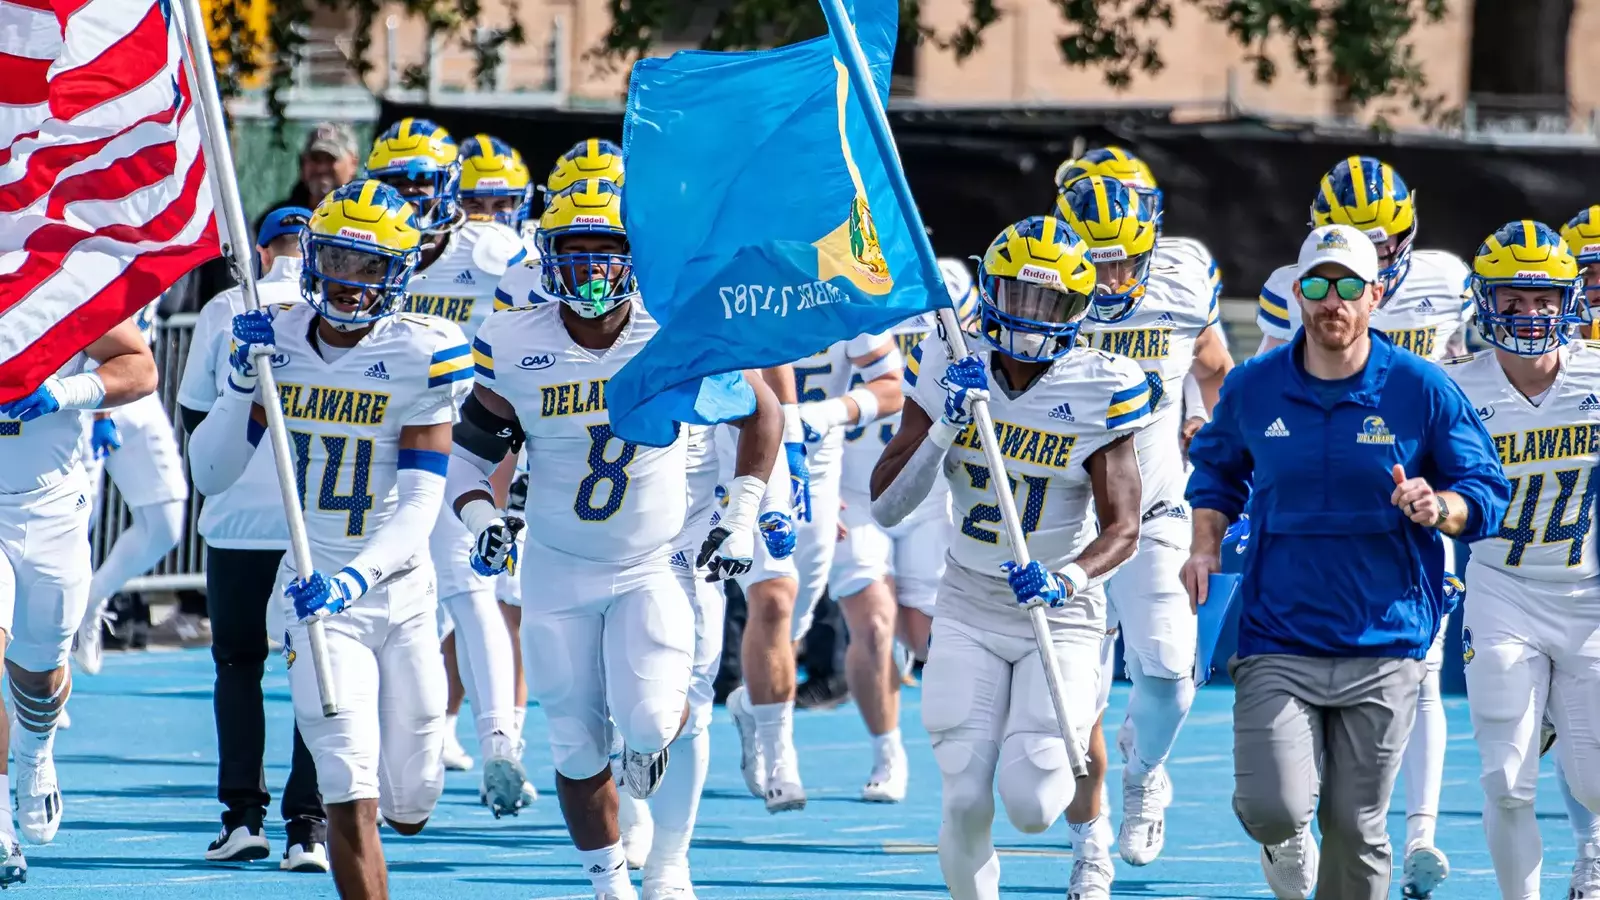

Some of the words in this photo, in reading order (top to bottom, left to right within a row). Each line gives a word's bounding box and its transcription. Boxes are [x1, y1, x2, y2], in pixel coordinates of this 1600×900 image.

[340, 228, 372, 241] Riddell
[1091, 250, 1123, 259] Riddell
[1023, 268, 1059, 282] Riddell
[521, 355, 550, 367] CAA
[363, 369, 390, 381] adidas
[277, 382, 391, 425] ELAWARE
[1048, 410, 1076, 423] adidas
[1492, 423, 1600, 467] ELAWARE
[573, 422, 638, 522] 8
[288, 429, 375, 538] 14
[960, 460, 1051, 546] 21
[1499, 468, 1593, 568] 44
[668, 559, 690, 568] adidas
